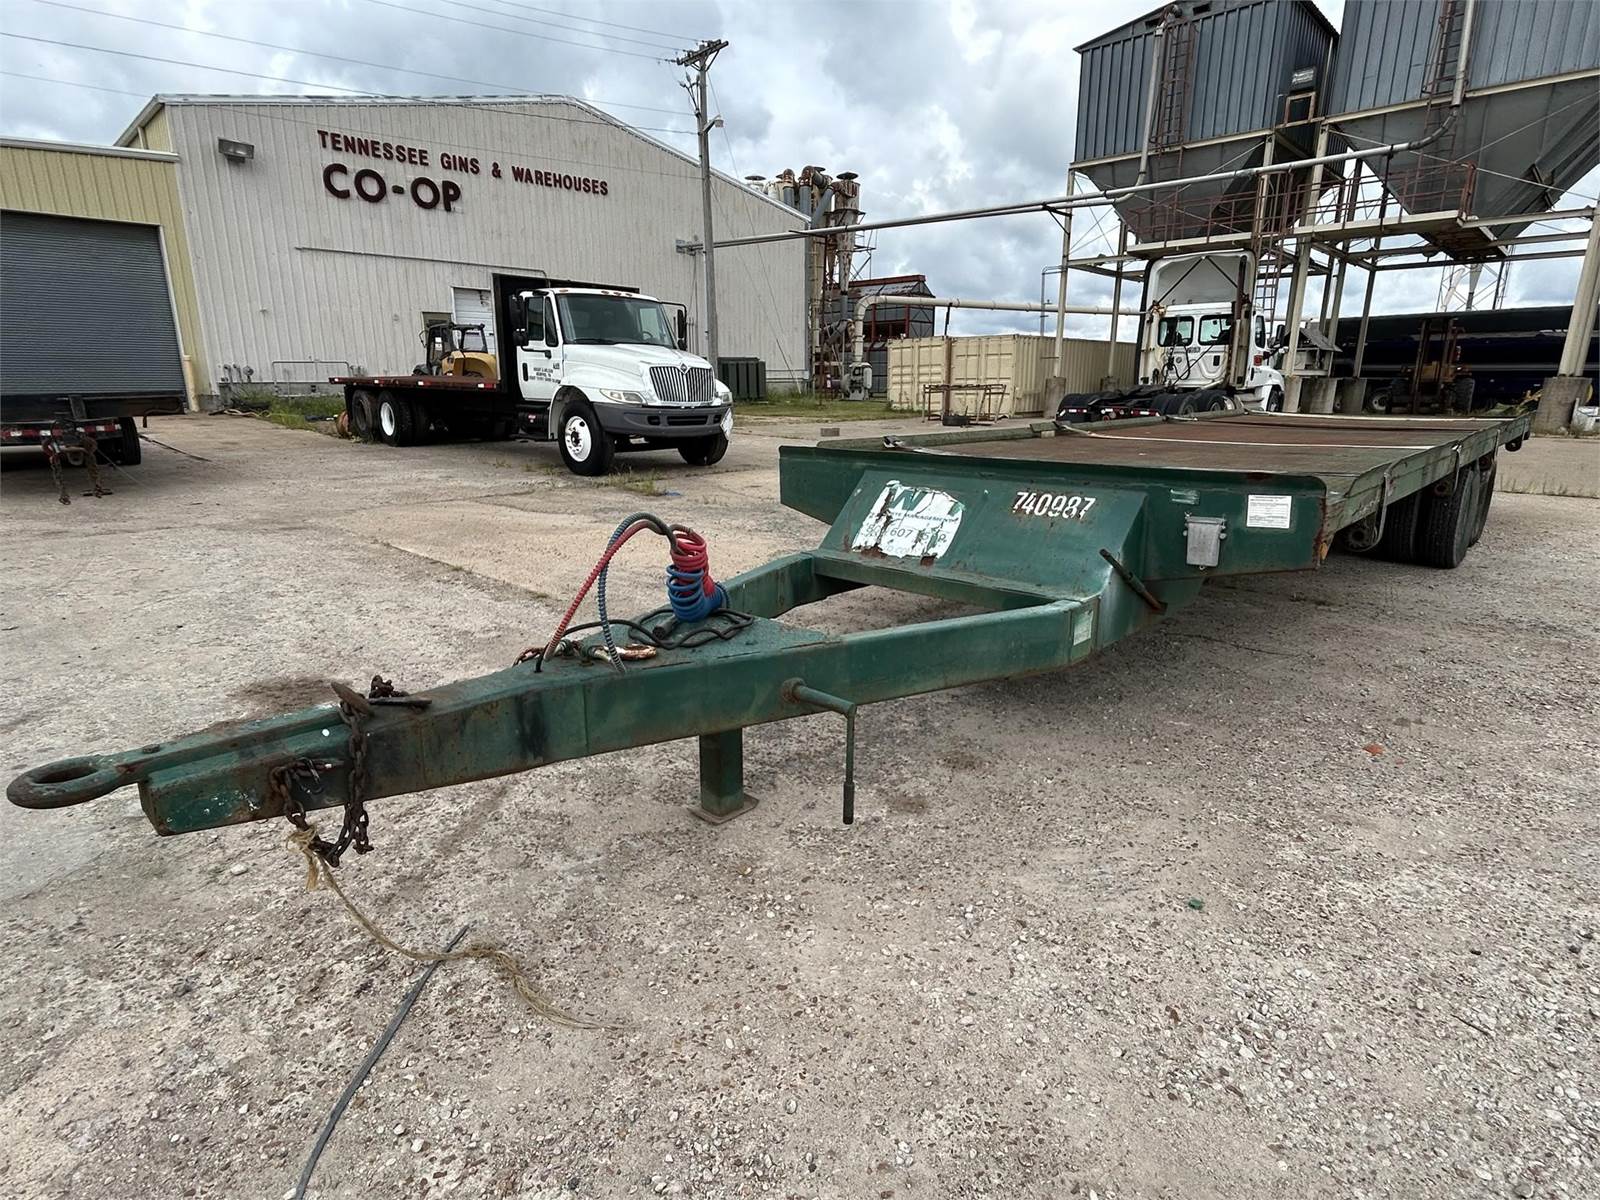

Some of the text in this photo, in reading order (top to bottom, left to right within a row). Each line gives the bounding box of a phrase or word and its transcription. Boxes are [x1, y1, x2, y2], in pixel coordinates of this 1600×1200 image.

[317, 130, 608, 196] TENNESSEE GINS & WAREHOUSES
[323, 163, 461, 212] CO-OP
[1012, 492, 1096, 519] 740987
[890, 527, 913, 539] 607
